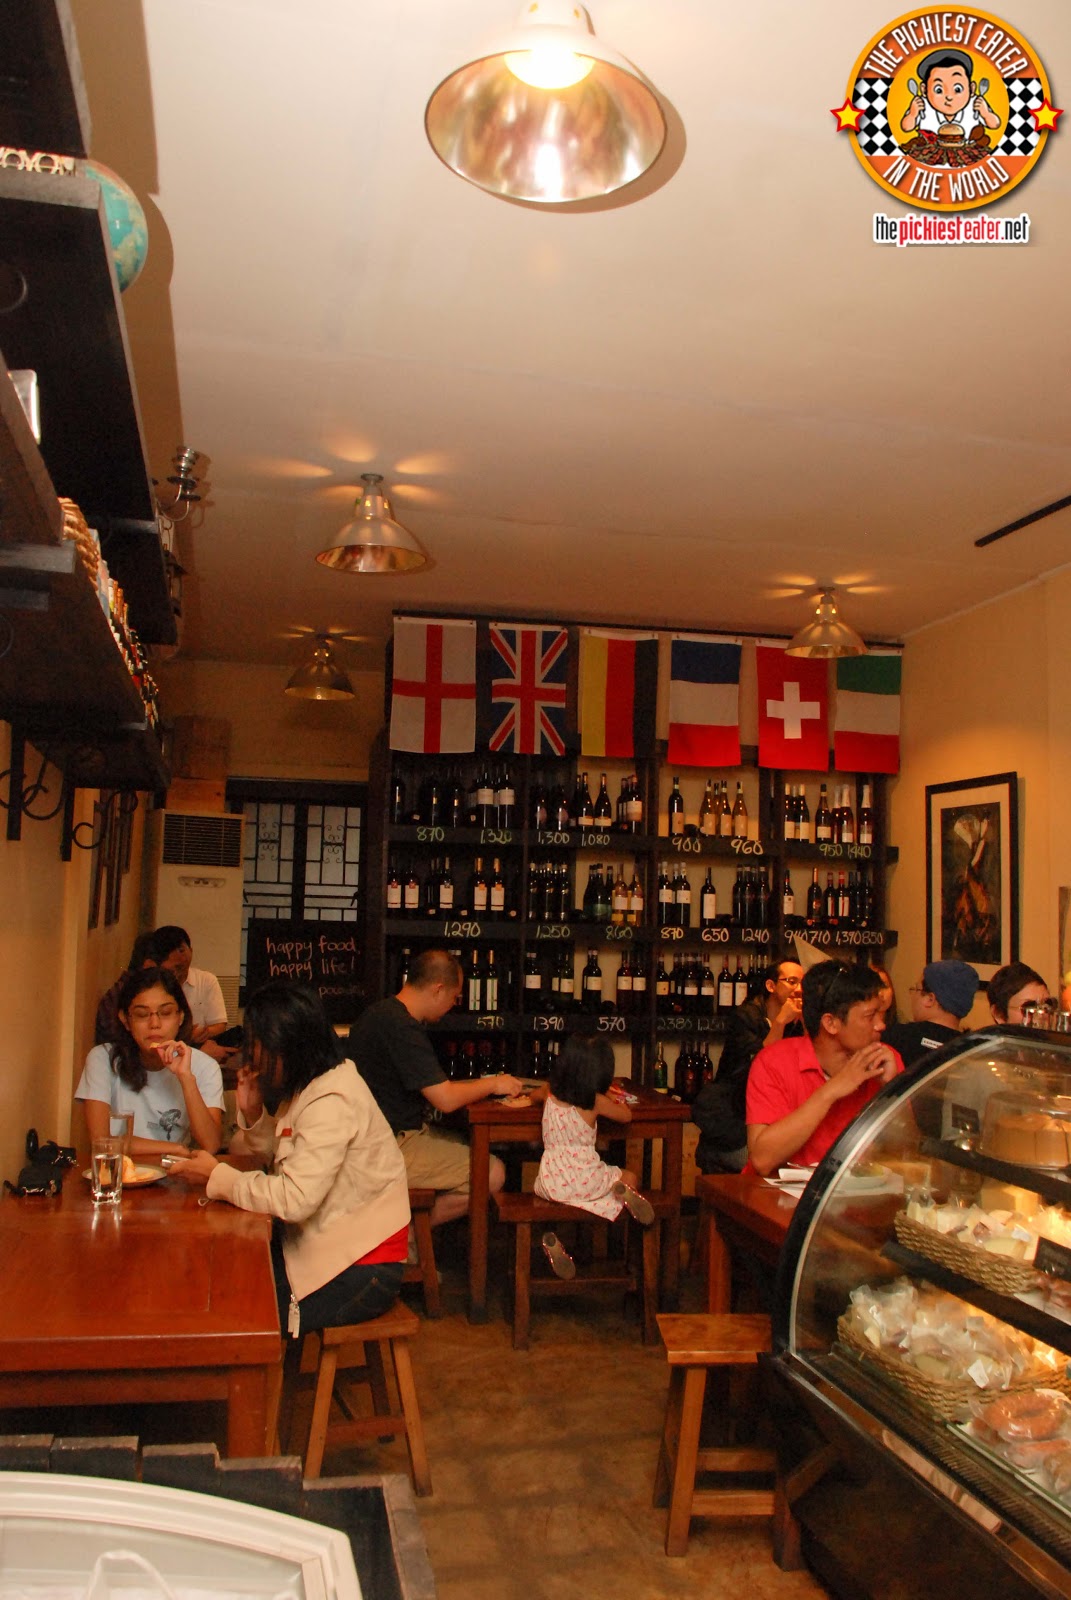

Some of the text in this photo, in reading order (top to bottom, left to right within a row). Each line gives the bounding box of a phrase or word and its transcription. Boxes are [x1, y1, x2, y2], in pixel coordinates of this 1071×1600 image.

[416, 827, 445, 842] 870
[537, 831, 571, 845] 1,300
[581, 833, 611, 847] 1,080
[672, 837, 701, 853] 900
[731, 838, 764, 855] 960
[819, 843, 843, 857] 950
[443, 921, 481, 938] 1,290
[660, 927, 684, 940] 870
[701, 927, 729, 942] 650
[266, 936, 313, 961] happy
[269, 959, 313, 981] happy
[476, 1015, 505, 1030] 570
[597, 1016, 626, 1032] 570
